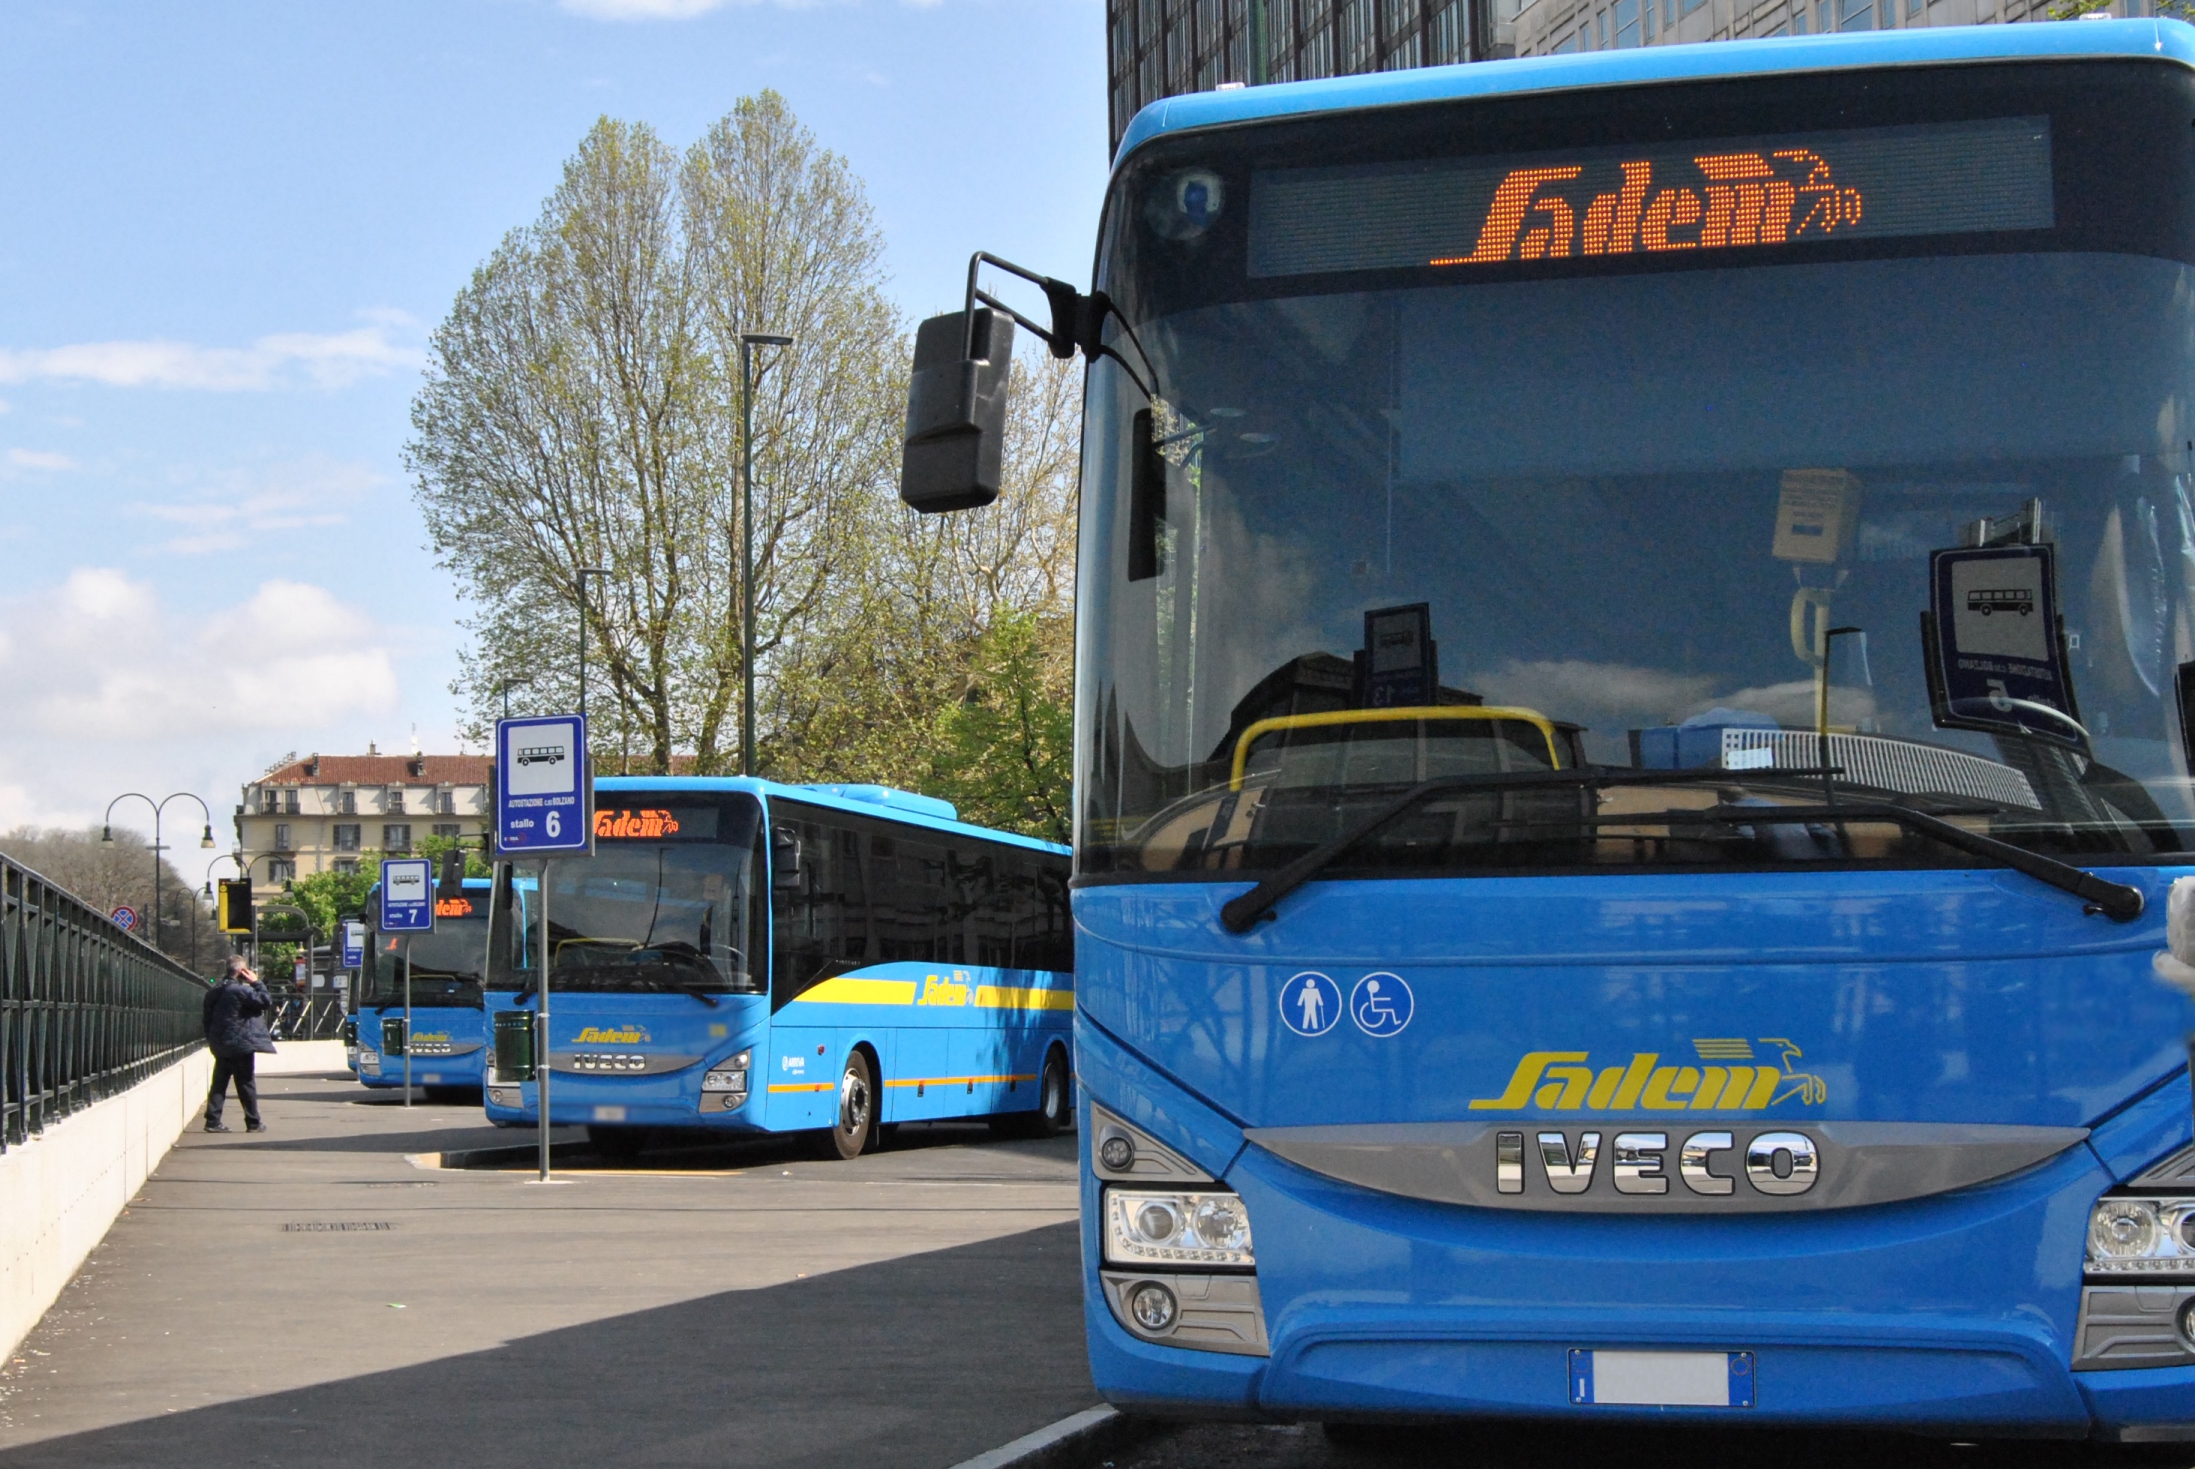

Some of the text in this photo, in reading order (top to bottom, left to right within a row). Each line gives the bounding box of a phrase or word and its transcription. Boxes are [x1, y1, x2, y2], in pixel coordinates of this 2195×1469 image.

[1430, 159, 1796, 265] Sadem
[553, 796, 575, 806] BOLZANO
[510, 810, 562, 838] stallo 6
[408, 908, 418, 924] 7
[917, 974, 967, 1006] Sadem
[571, 1027, 641, 1043] Sadem
[573, 1053, 647, 1071] IVECO
[1468, 1050, 1781, 1110] Sadem
[1496, 1130, 1821, 1197] IVECO
